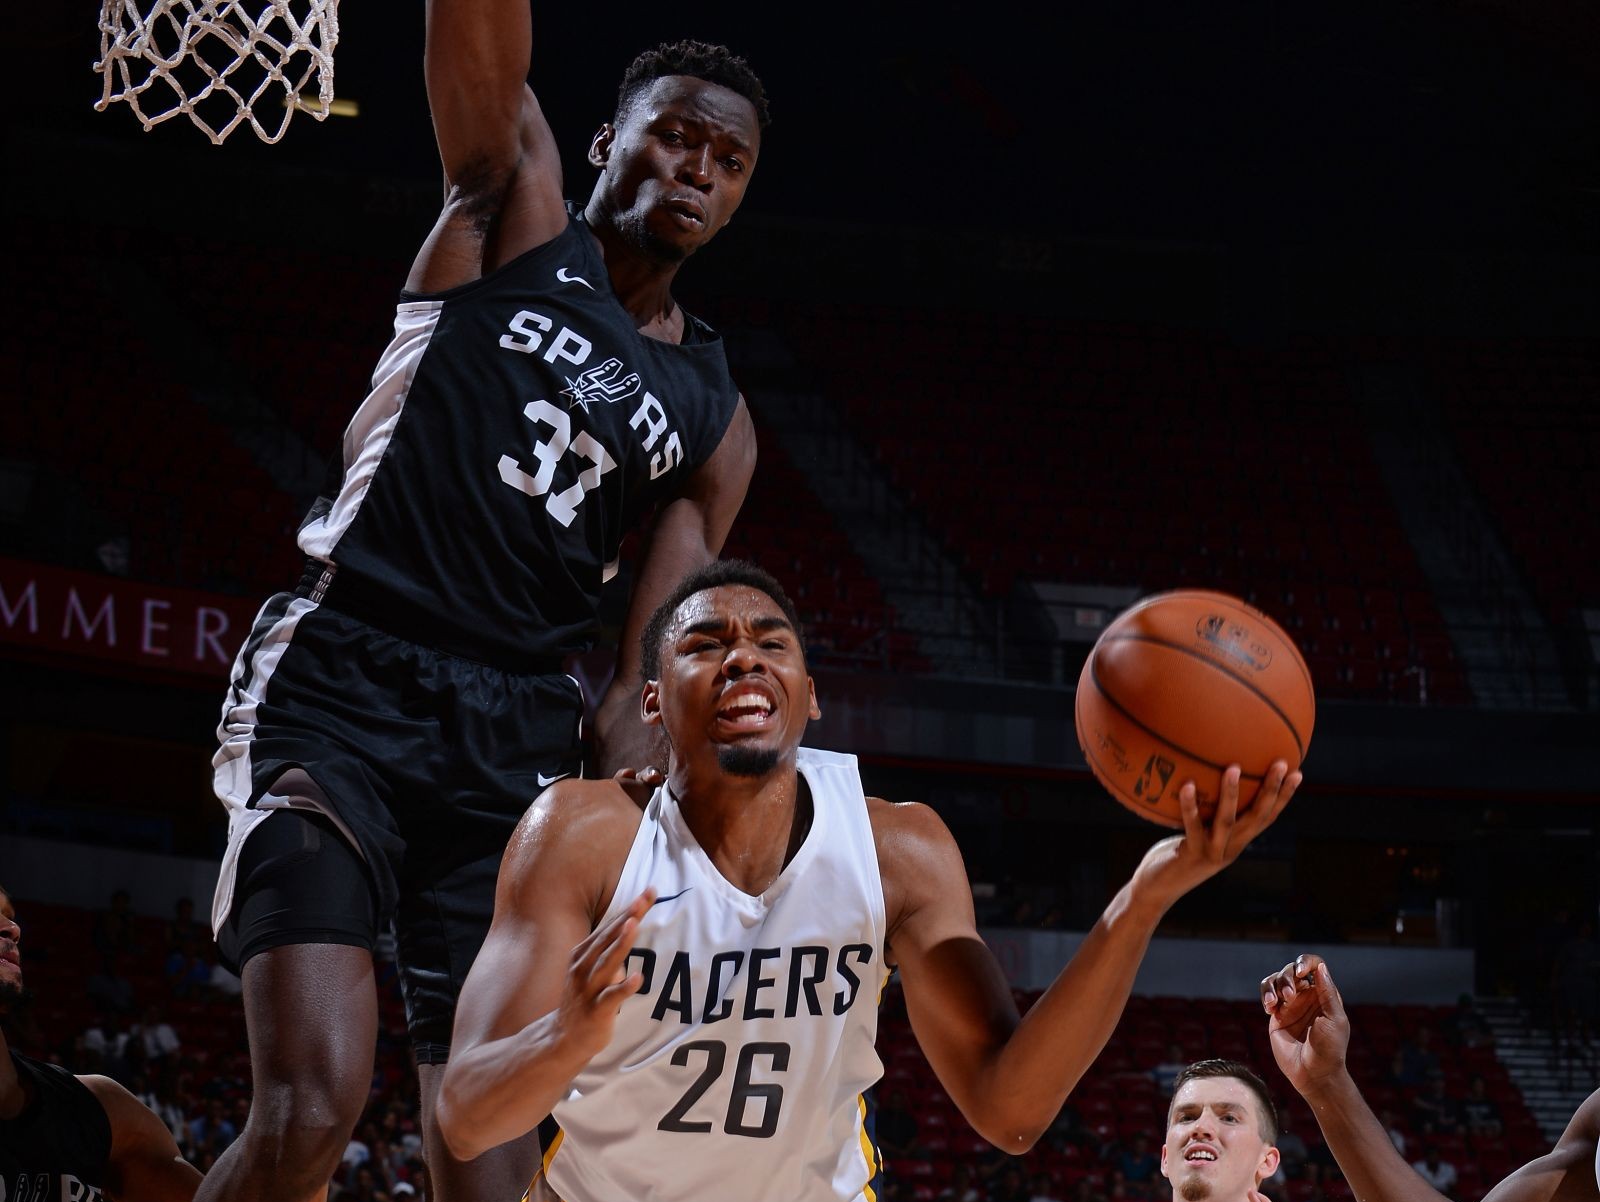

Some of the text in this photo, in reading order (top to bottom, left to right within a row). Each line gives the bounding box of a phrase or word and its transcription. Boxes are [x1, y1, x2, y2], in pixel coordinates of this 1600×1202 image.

[499, 310, 684, 481] SPURS
[497, 400, 617, 528] 37
[617, 943, 873, 1025] PACERS
[657, 1039, 791, 1139] 26
